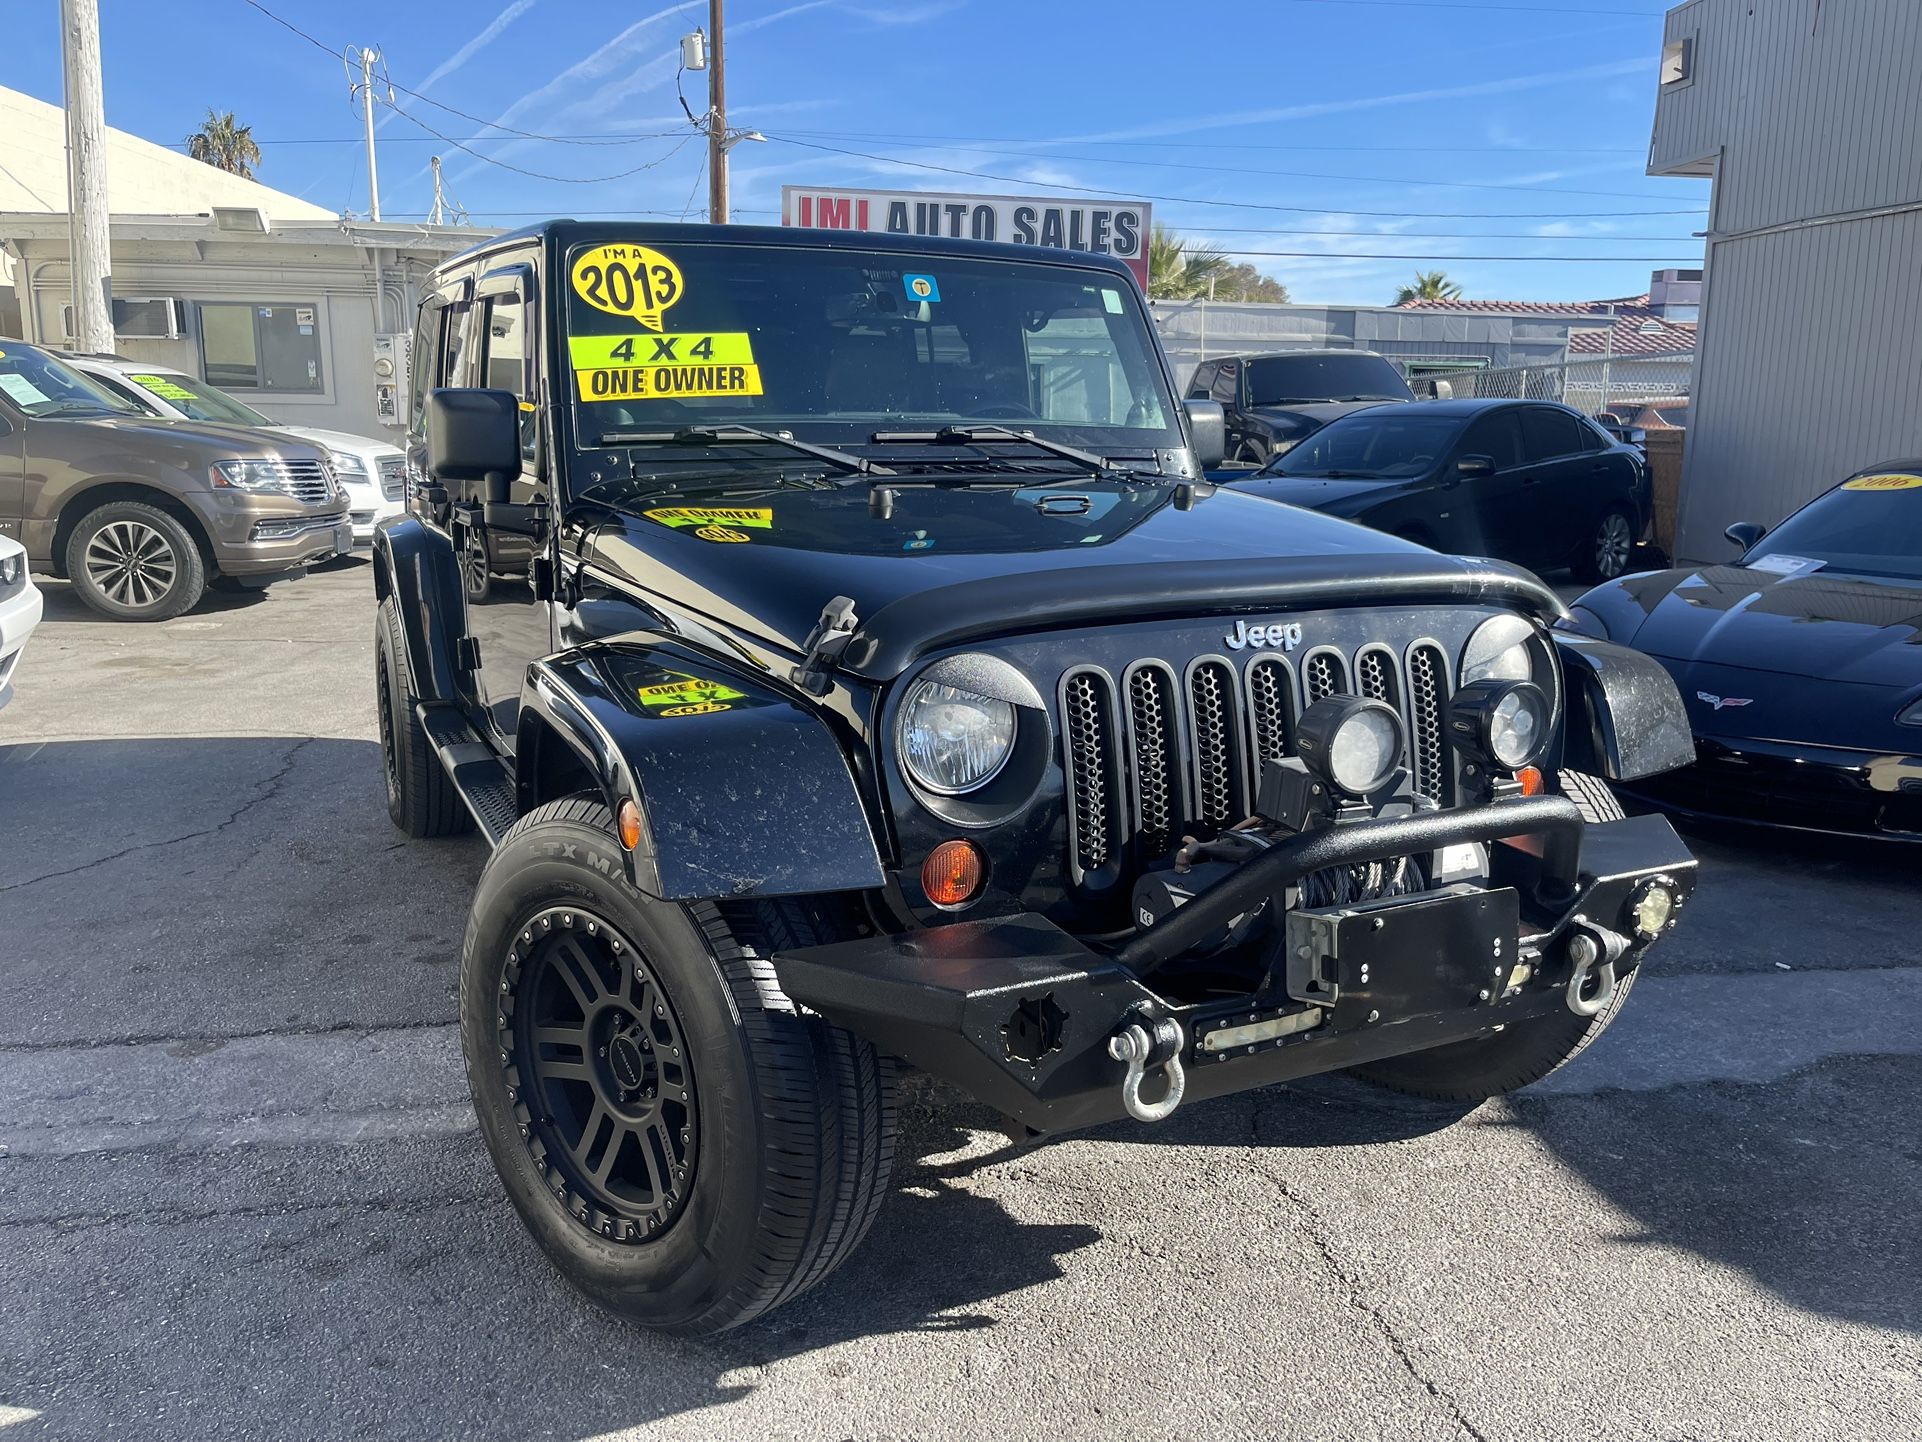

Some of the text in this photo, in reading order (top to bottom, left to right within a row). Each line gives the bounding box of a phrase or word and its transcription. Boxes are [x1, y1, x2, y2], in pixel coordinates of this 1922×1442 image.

[887, 201, 997, 240] AUTO
[1012, 205, 1141, 256] SALES
[603, 248, 643, 259] I'M A
[580, 262, 677, 311] 2013
[610, 336, 716, 363] 4 X 4
[591, 366, 748, 396] ONE OWNER
[1224, 620, 1302, 652] Jeep
[529, 842, 577, 859] LTX
